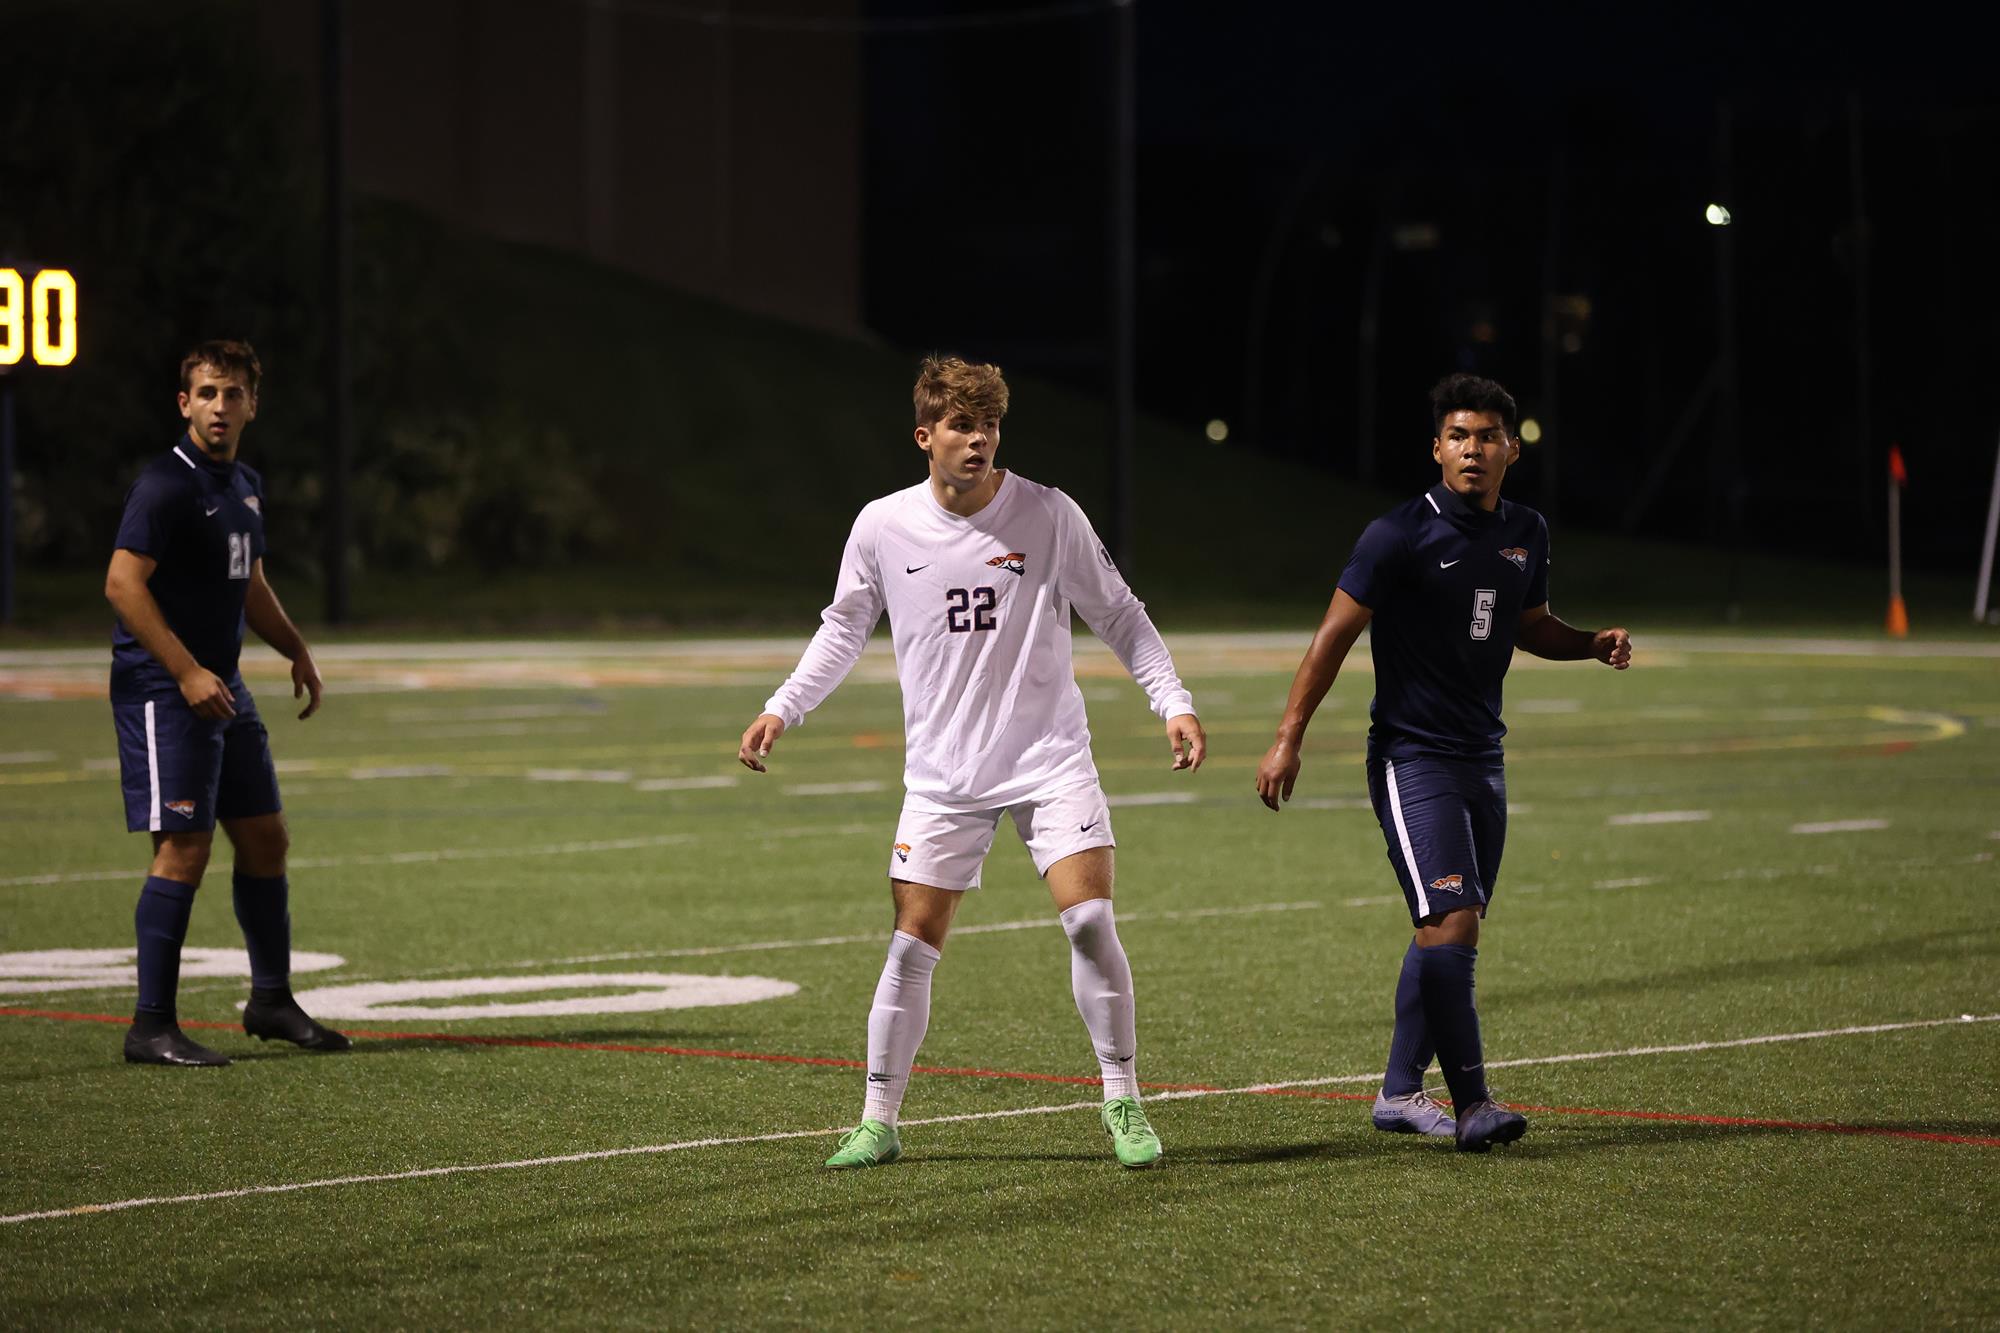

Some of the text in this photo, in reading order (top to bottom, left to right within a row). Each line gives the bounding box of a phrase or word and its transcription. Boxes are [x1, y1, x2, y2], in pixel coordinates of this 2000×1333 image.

[228, 532, 251, 579] 21
[946, 586, 997, 633] 22
[1469, 588, 1497, 640] 5
